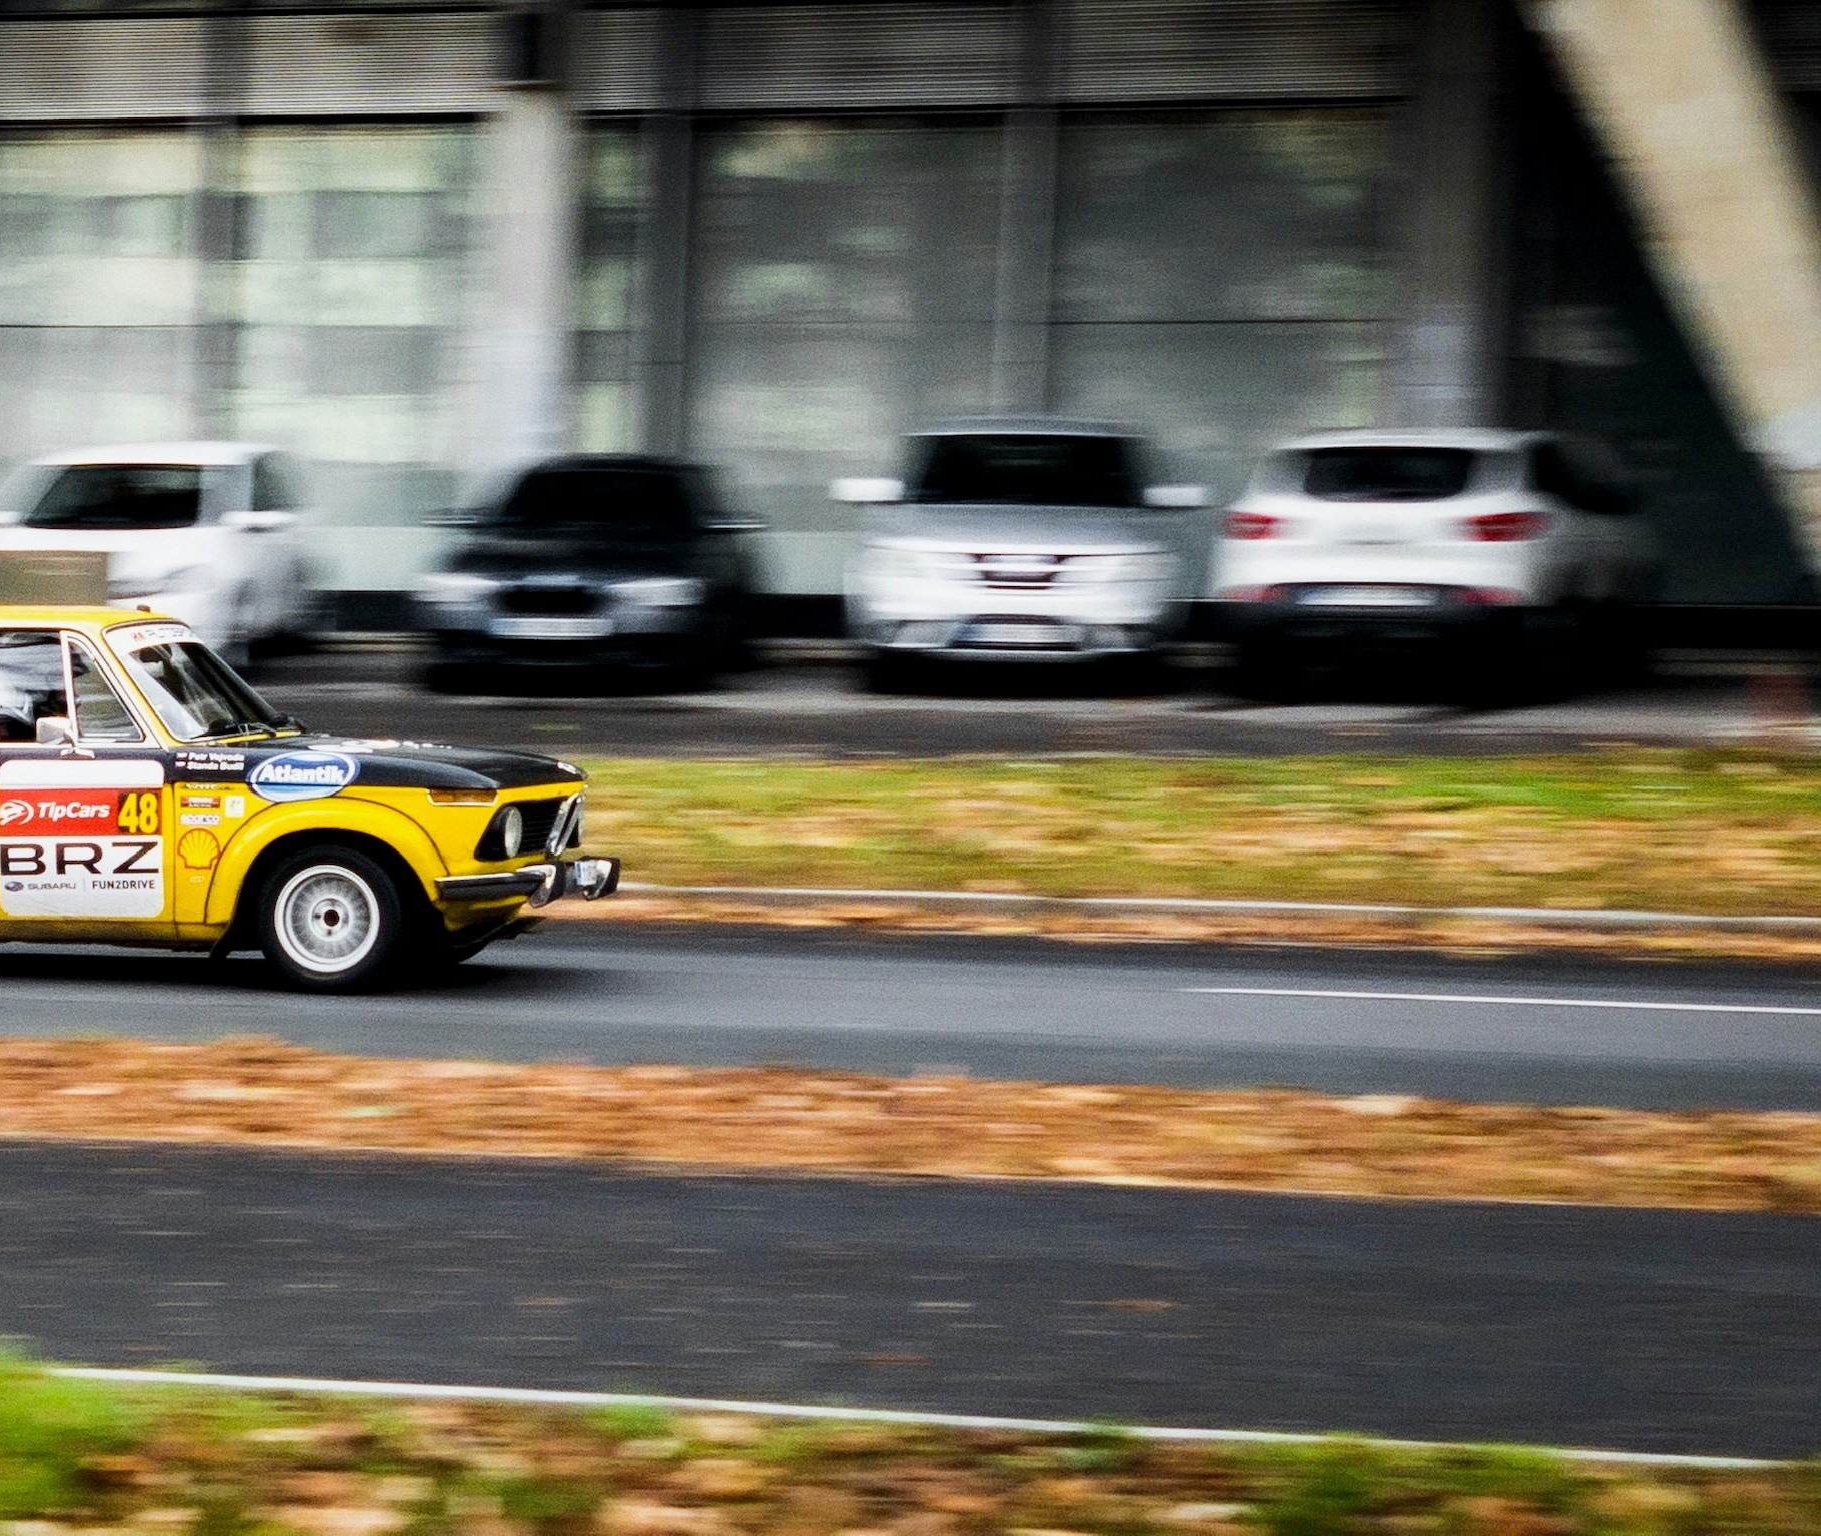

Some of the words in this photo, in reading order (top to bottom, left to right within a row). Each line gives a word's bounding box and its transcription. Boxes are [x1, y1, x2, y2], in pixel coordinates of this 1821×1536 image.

[259, 763, 345, 783] Atlantik
[37, 802, 110, 822] TipCars
[118, 793, 158, 834] 48
[0, 841, 159, 876] BRZ
[28, 882, 76, 890] SUBARU
[92, 879, 155, 890] FUN2DRIVE
